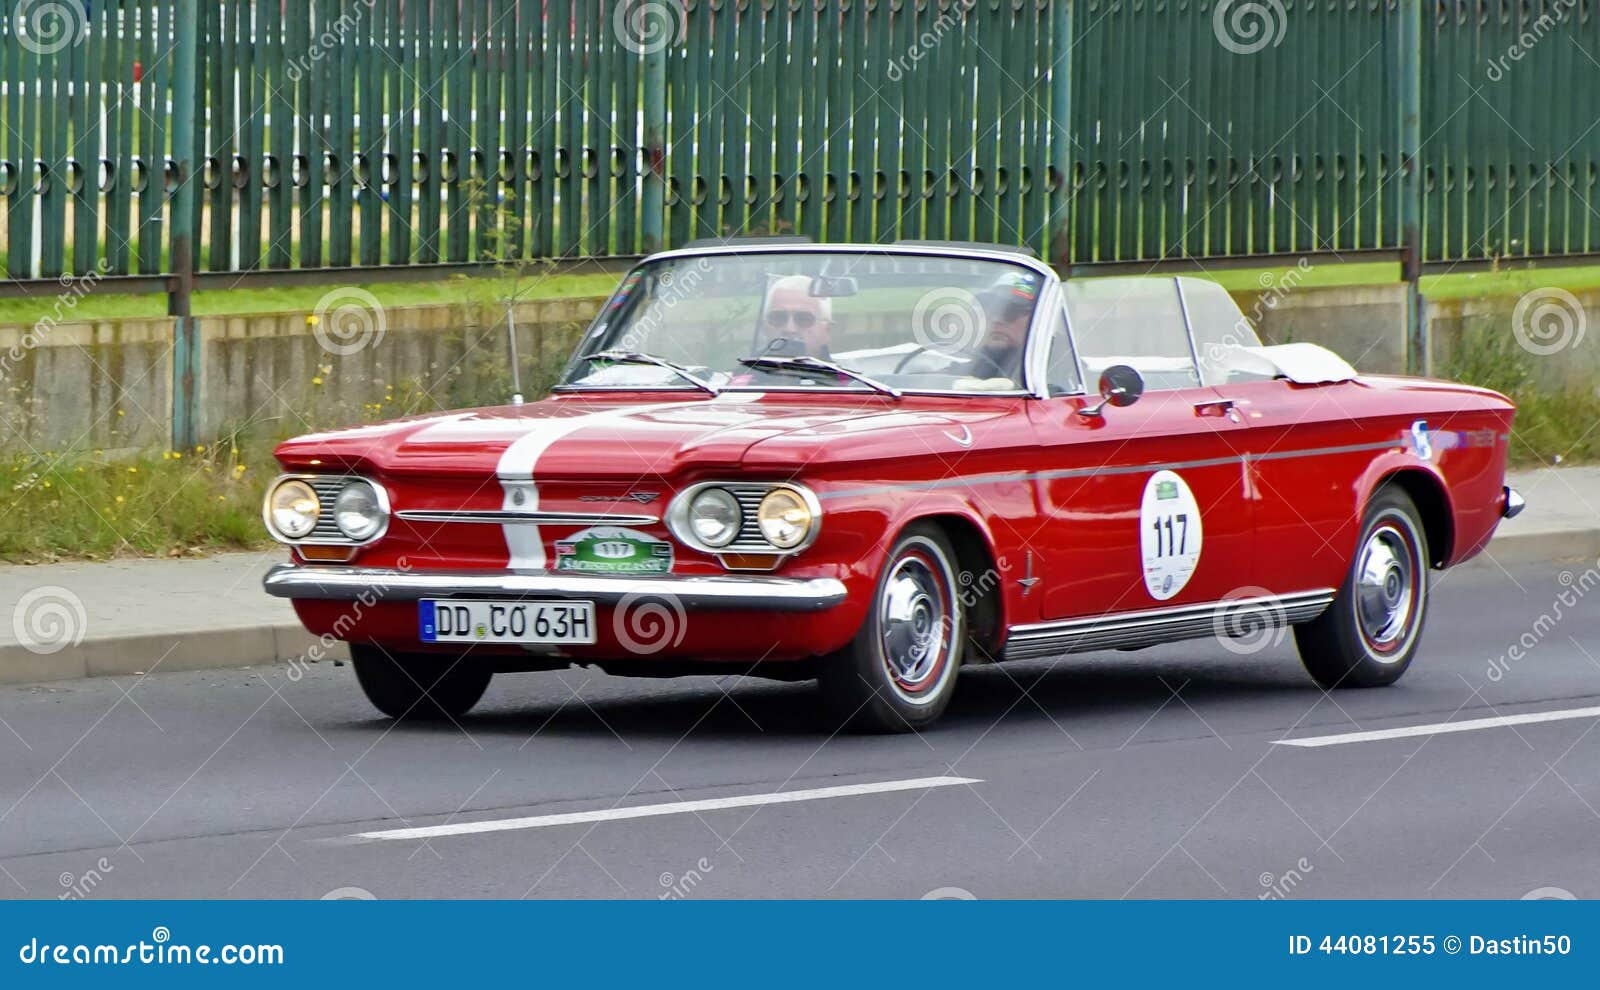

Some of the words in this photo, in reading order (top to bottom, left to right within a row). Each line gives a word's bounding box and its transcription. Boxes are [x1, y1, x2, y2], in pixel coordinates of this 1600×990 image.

[602, 544, 629, 555] 117
[1154, 514, 1187, 557] 117
[437, 605, 470, 636] DD
[535, 607, 589, 638] 63H
